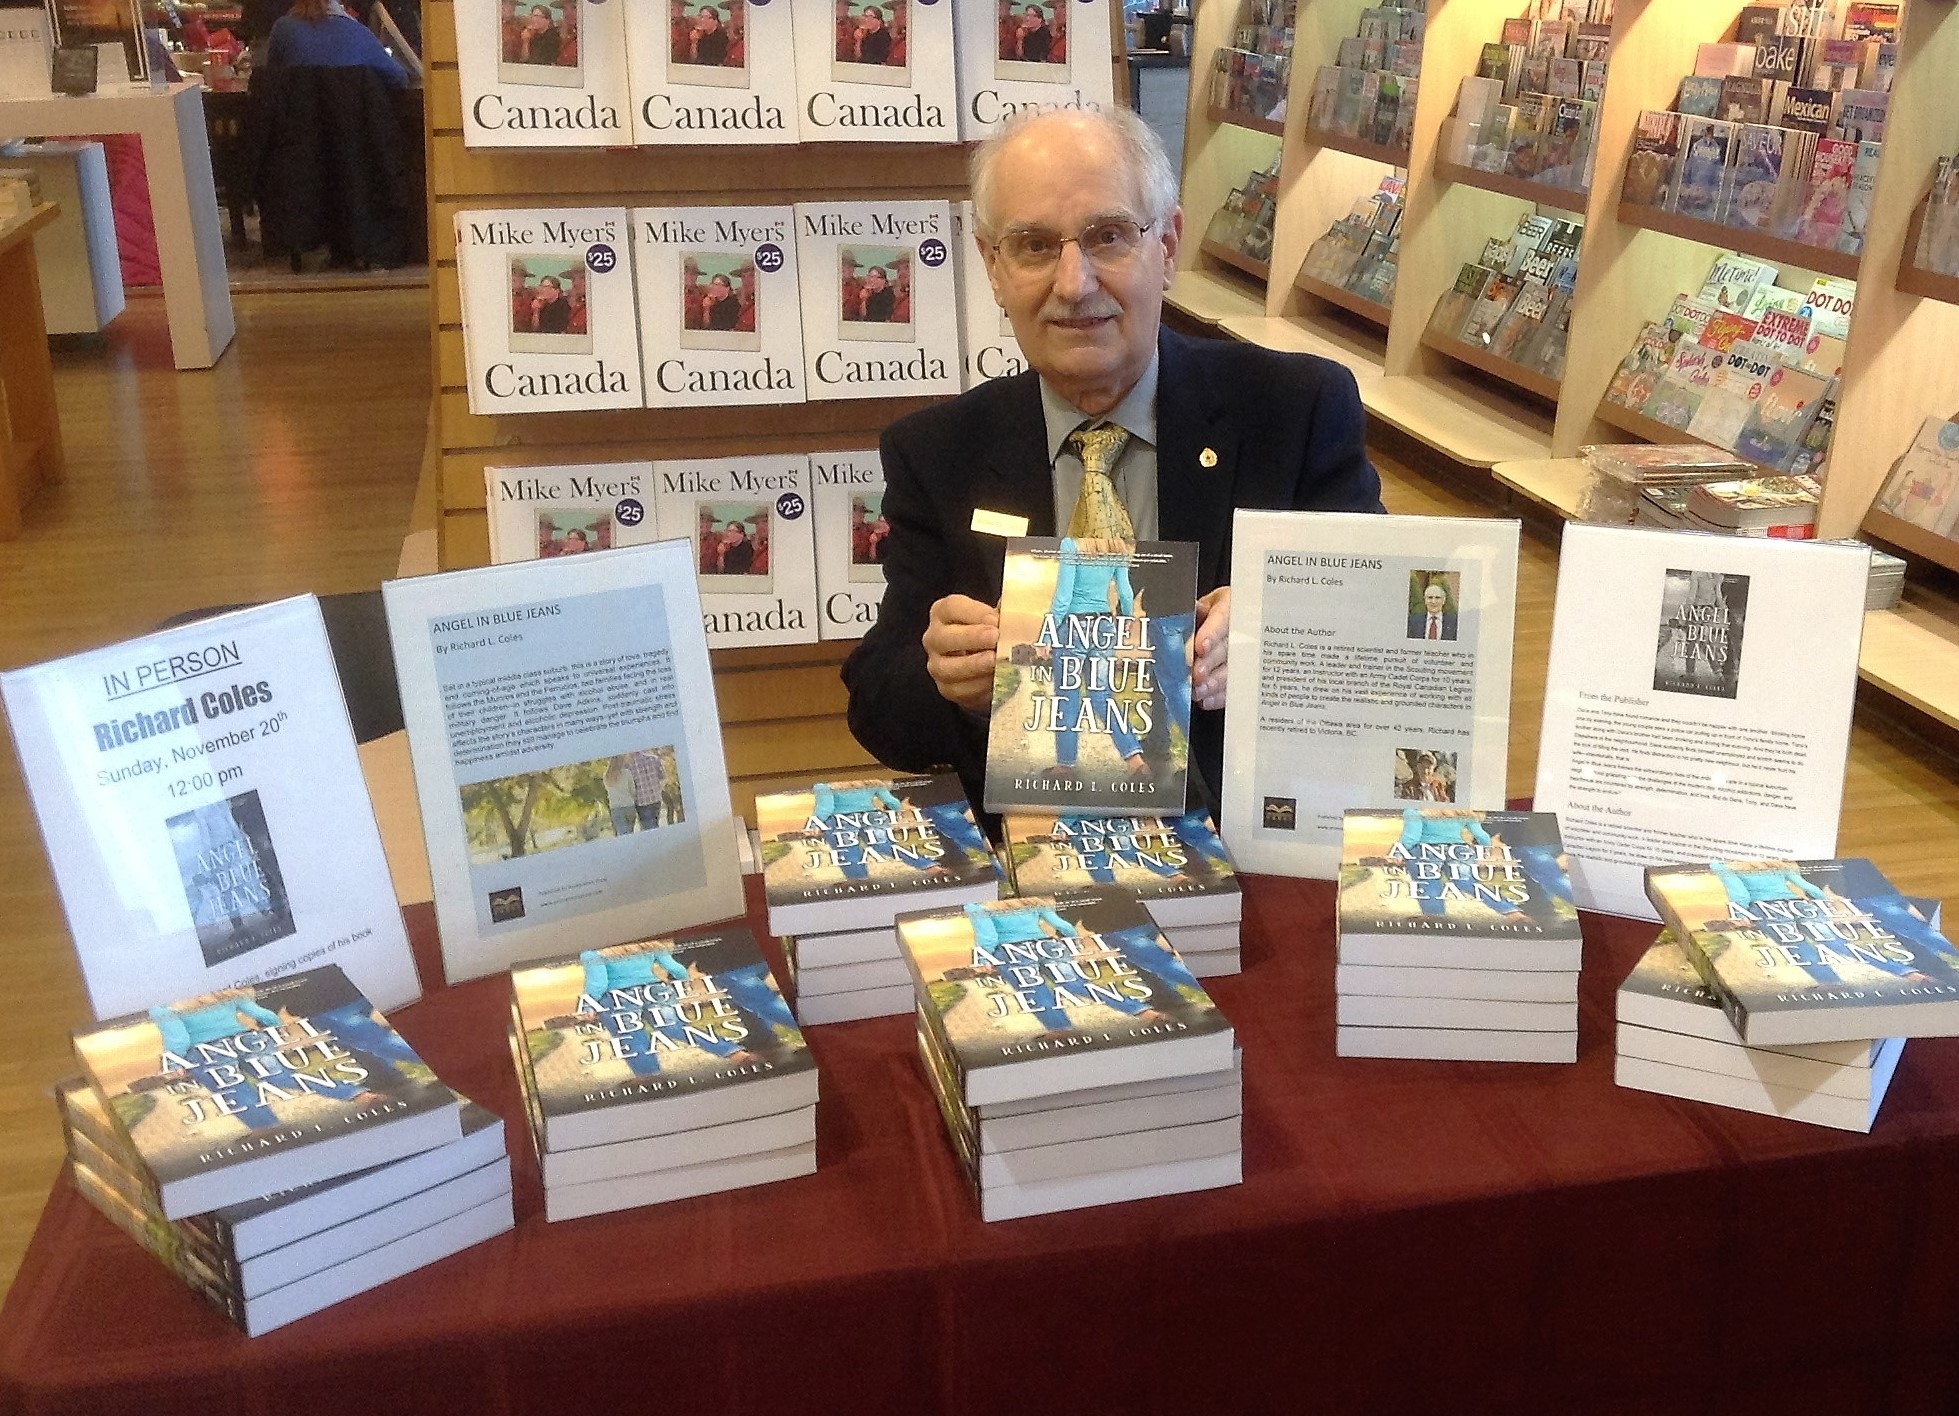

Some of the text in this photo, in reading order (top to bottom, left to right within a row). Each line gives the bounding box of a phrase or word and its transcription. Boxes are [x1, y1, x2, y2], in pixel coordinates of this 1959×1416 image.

[1755, 34, 1795, 73] bake
[472, 93, 621, 132] Canada
[642, 94, 785, 131] Canada
[807, 91, 946, 129] Canada
[1786, 96, 1831, 120] Mexican
[471, 223, 616, 252] Mike Myers
[645, 221, 785, 250] Mike Myers
[804, 214, 938, 242] Mike Myers
[587, 251, 615, 270] $25
[755, 249, 782, 269] $25
[920, 245, 946, 263] $25
[1807, 291, 1852, 316] DOT DO
[486, 361, 630, 398] Canada
[656, 358, 795, 394] Canada
[815, 348, 949, 386] Canada
[663, 470, 798, 495] Mike Myers
[817, 464, 873, 485] Mike
[501, 477, 641, 503] Mike Myers
[617, 505, 642, 522] $25
[778, 499, 802, 516] $25
[1267, 555, 1383, 570] ANGEL IN BLUE JEANS
[1266, 575, 1276, 584] By
[1279, 575, 1310, 585] Richard
[1320, 578, 1343, 587] Coles
[433, 604, 562, 634] ANGEL IN BLUE JEANS
[705, 600, 806, 634] anada
[1675, 604, 1731, 626] ANGEL
[436, 644, 449, 655] By
[450, 637, 486, 651] Richard
[498, 632, 524, 644] Coles
[1034, 613, 1156, 652] ANGEL
[1264, 625, 1336, 637] About the Author
[1688, 624, 1730, 645] BLUE
[1671, 641, 1728, 662] JEANS
[103, 640, 240, 697] IN PERSON
[1030, 656, 1156, 693] IN BLUE
[93, 680, 273, 752] Richard Coles
[1023, 695, 1154, 736] JEANS
[97, 711, 288, 787] Sunday, November 20th
[168, 764, 244, 799] 12:00 pm
[1015, 778, 1084, 792] RICHARD
[1111, 782, 1156, 793] COLES
[803, 808, 934, 835] ANGEL
[1568, 801, 1632, 817] About the Author
[801, 826, 941, 849] IN BLUE
[1051, 816, 1176, 838] ANGEL
[196, 836, 259, 875] ANGEL
[801, 841, 946, 870] JEANS
[1050, 832, 1183, 853] IN BLUE
[1388, 842, 1522, 863] ANGEL
[1051, 848, 1189, 872] JEANS
[1382, 862, 1527, 883] IN BLUE
[803, 874, 962, 898] RICHARD COLES
[1380, 879, 1531, 904] JEANS
[1727, 897, 1874, 922] ANGEL
[1376, 920, 1457, 931] RICHARD
[1490, 924, 1544, 933] COLES
[1736, 919, 1897, 945] IN BLUE
[264, 959, 297, 977] signing
[297, 949, 326, 965] copies
[337, 937, 351, 948] his
[351, 927, 373, 943] book
[971, 933, 1122, 968] ANGEL
[1755, 940, 1916, 969] JEANS
[976, 954, 1140, 990] IN BLUE
[575, 974, 729, 1016] ANGEL
[987, 977, 1155, 1019] JEANS
[1661, 983, 1716, 1001] RICHA
[1777, 984, 1957, 1003] RICHARD COLES
[575, 995, 739, 1036] IN BLUE
[159, 1017, 332, 1077] ANGEL
[578, 1017, 750, 1066] JEANS
[1002, 1021, 1189, 1057] RICHARD COLES
[166, 1035, 351, 1096] IN BLUE
[181, 1058, 371, 1127] JEANS
[584, 1080, 678, 1103] RICHARD
[715, 1062, 775, 1080] COLES
[199, 1128, 304, 1164] RICHARD
[344, 1101, 409, 1125] COLES
